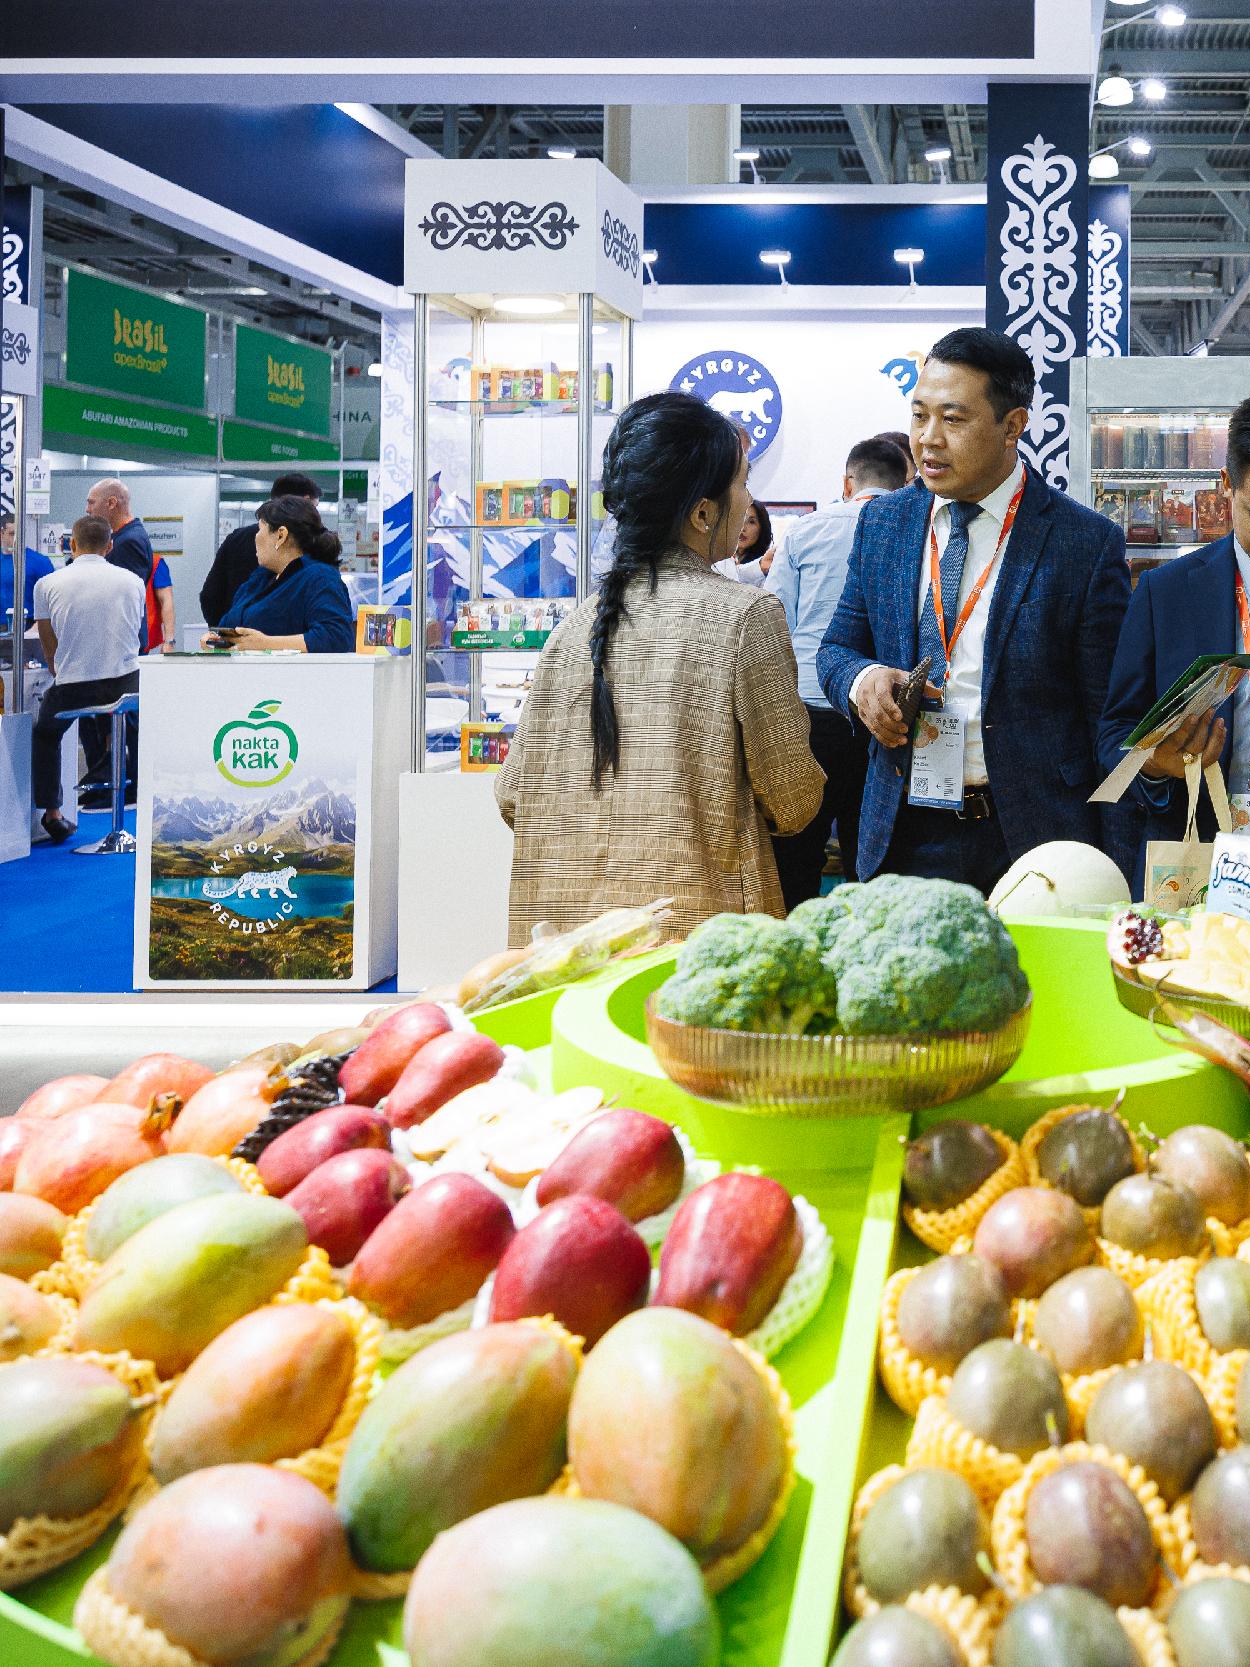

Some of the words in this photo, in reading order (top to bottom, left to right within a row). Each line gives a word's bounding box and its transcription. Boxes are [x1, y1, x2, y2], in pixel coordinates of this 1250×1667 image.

[680, 358, 762, 394] KYRGYZ
[332, 410, 372, 423] HINA
[154, 422, 189, 438] PRODUCTS
[232, 736, 279, 750] nakta
[232, 751, 279, 769] kak
[209, 841, 285, 874] KYRGYZ
[209, 901, 293, 934] REPUBLIC
